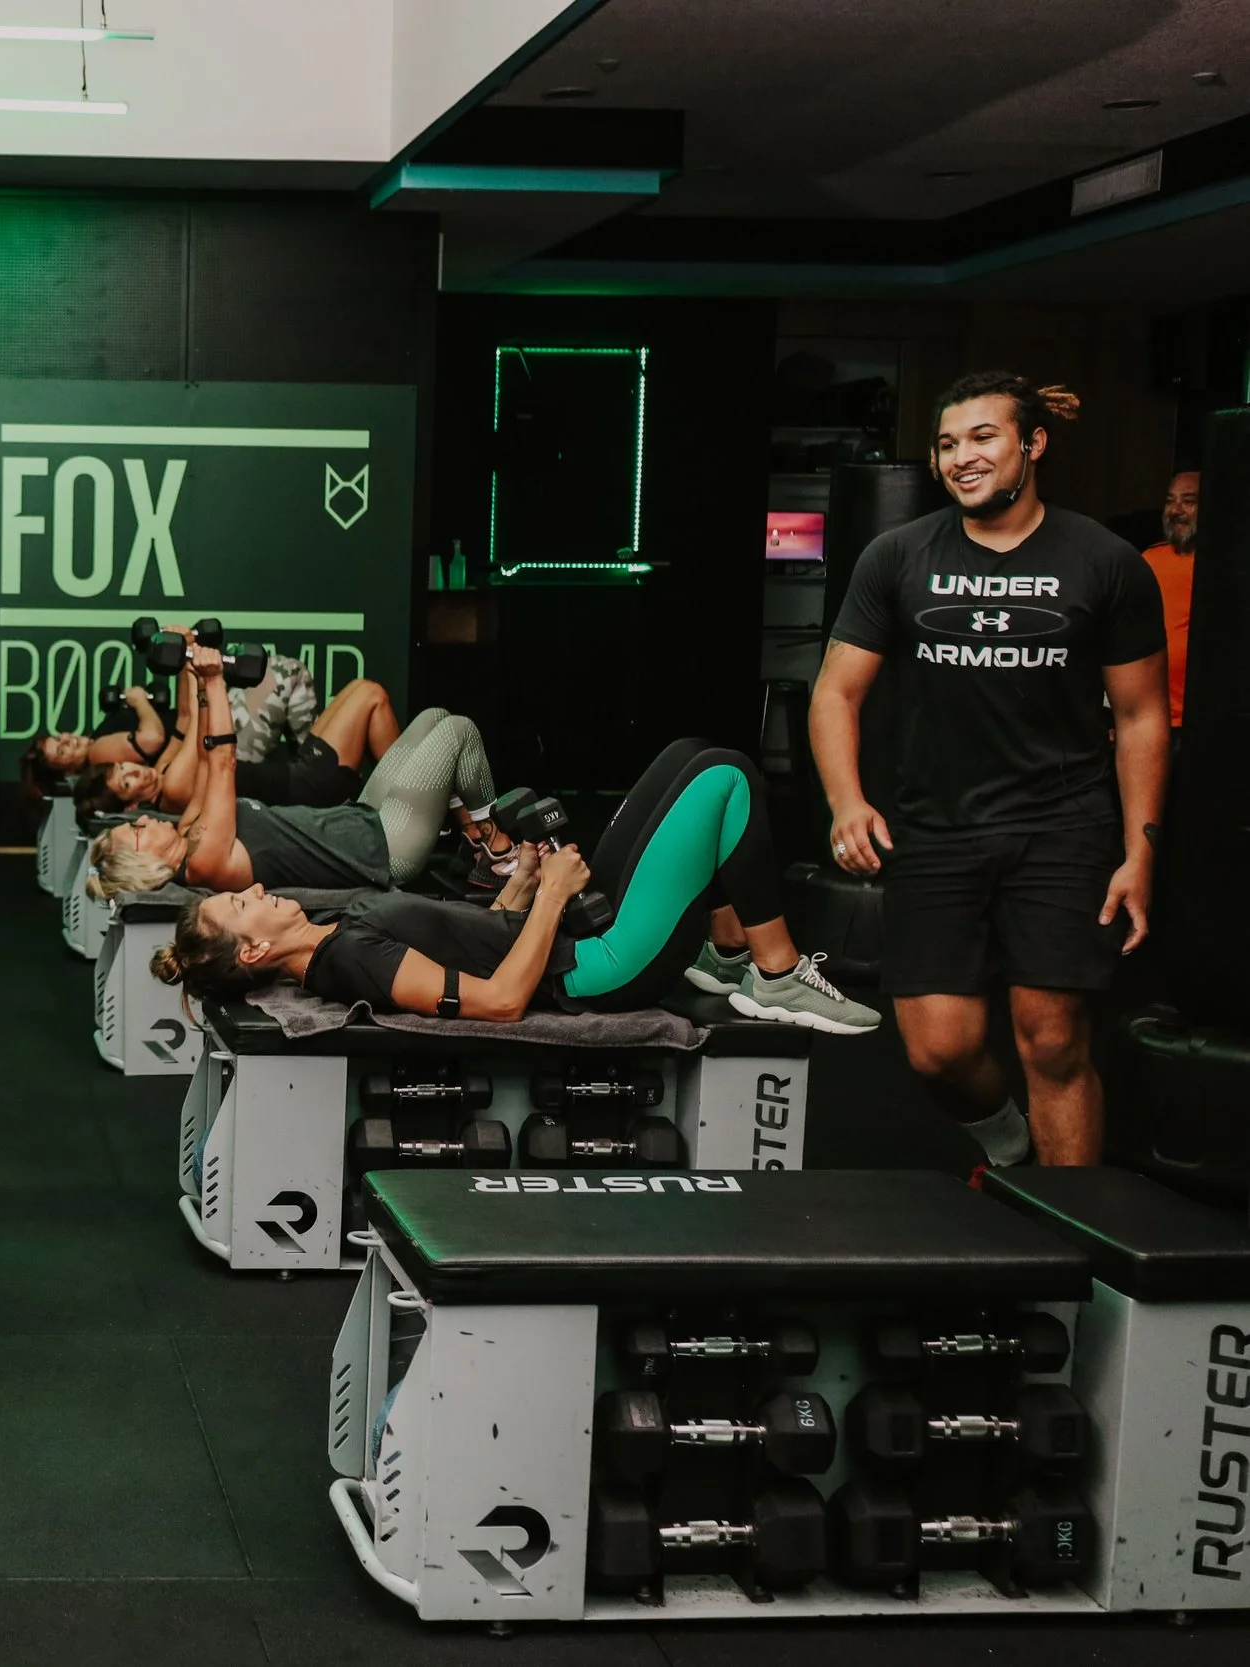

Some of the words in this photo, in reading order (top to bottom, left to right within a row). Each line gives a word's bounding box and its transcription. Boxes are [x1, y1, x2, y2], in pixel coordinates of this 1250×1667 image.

[1, 456, 187, 597] FOX
[930, 574, 1060, 597] UNDER
[916, 642, 1068, 668] ARMOUR
[543, 810, 559, 824] 4KG
[752, 1073, 791, 1170] TER
[470, 1176, 743, 1193] RUSTER
[795, 1399, 815, 1428] 6KG
[1193, 1324, 1250, 1580] RUSTER
